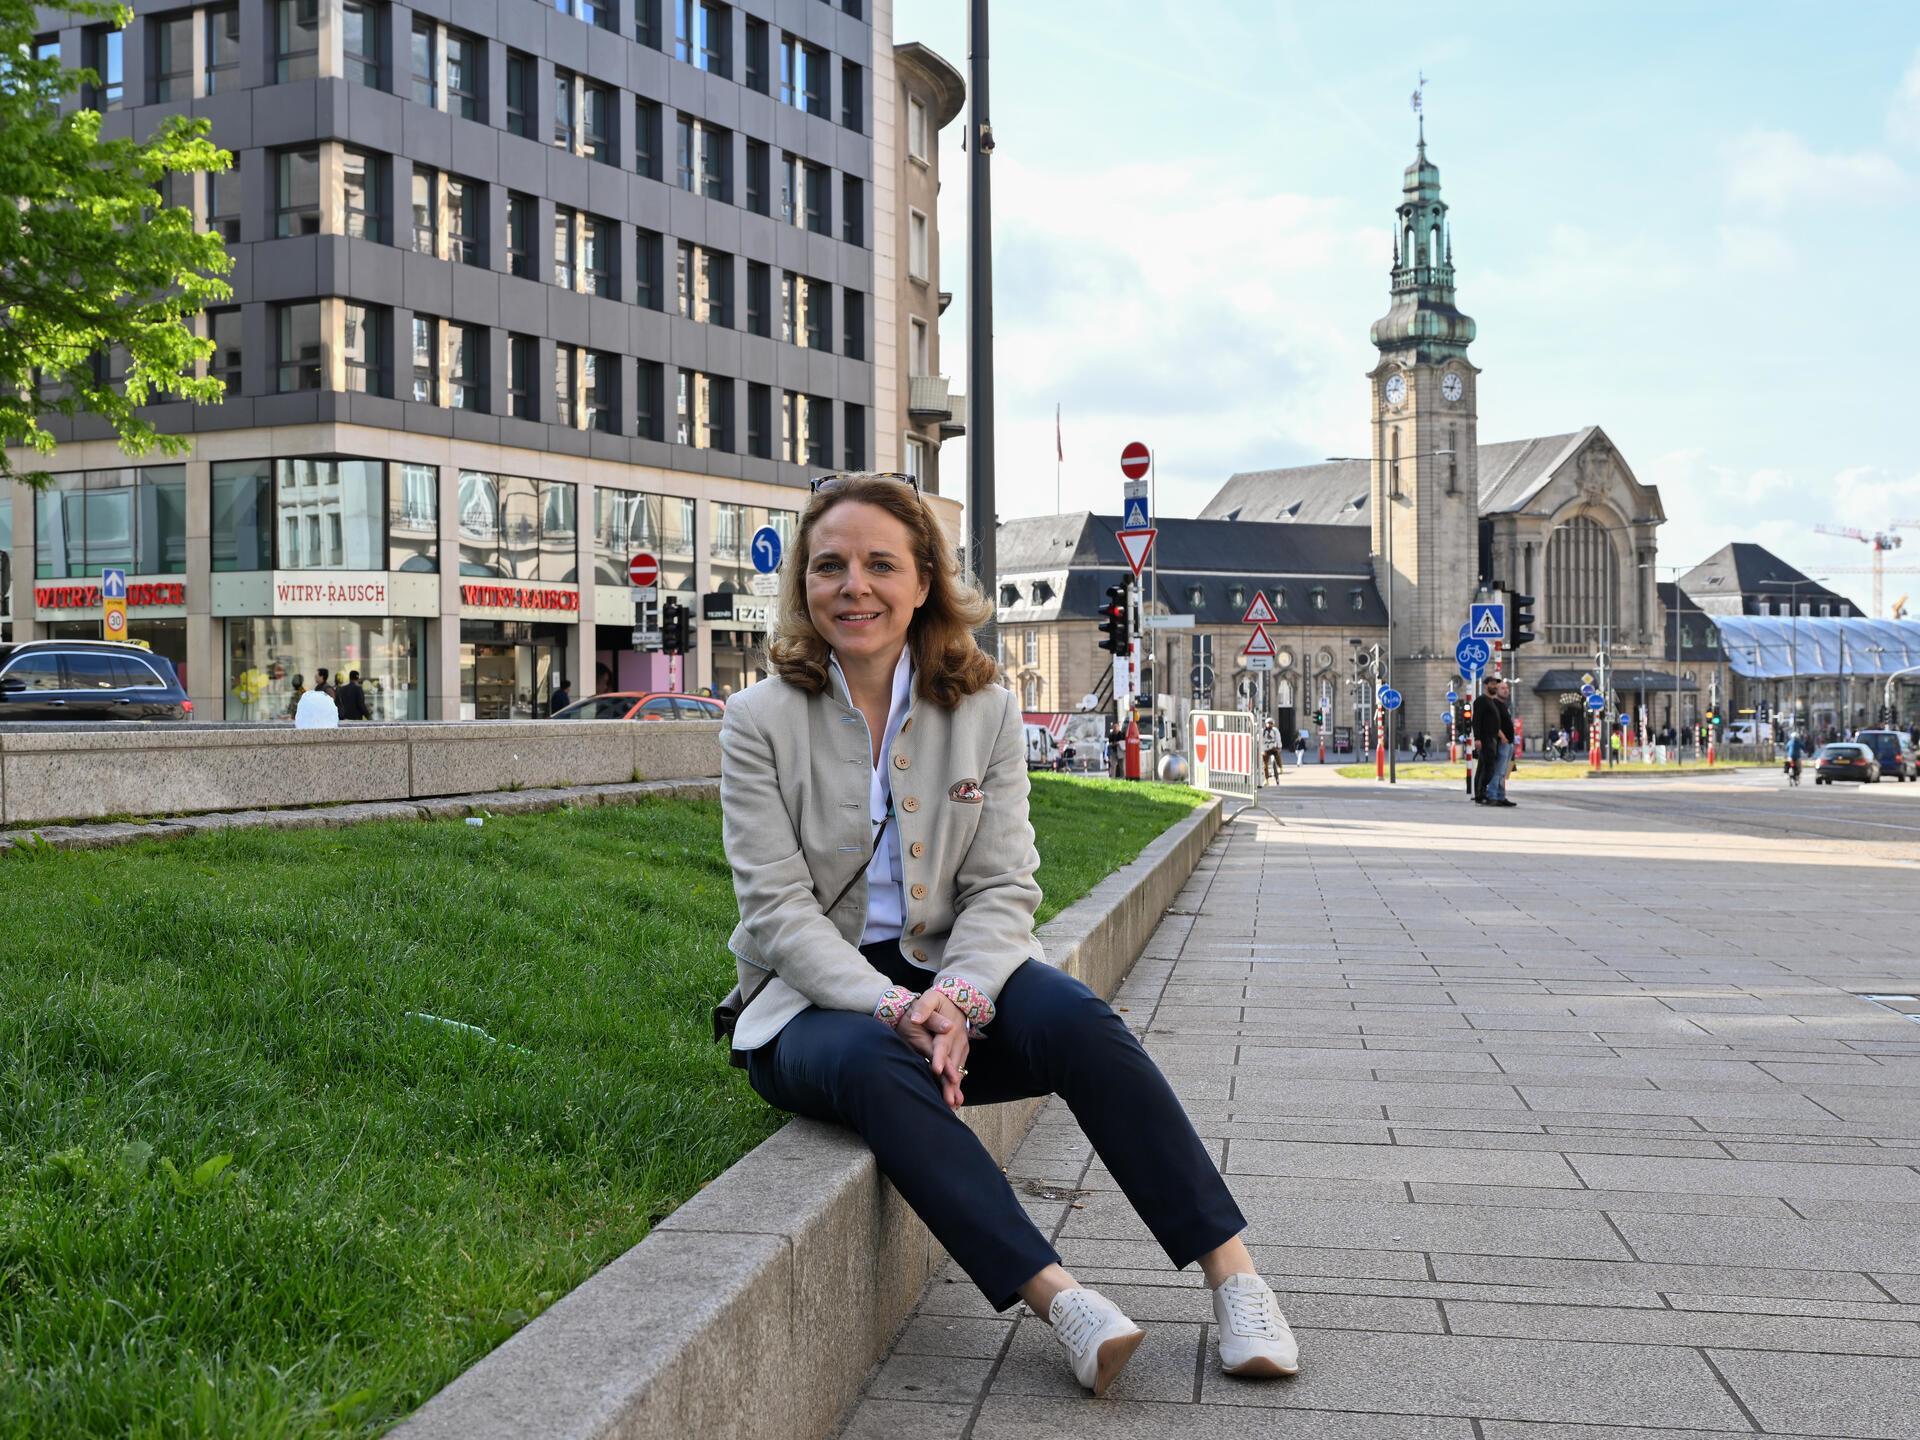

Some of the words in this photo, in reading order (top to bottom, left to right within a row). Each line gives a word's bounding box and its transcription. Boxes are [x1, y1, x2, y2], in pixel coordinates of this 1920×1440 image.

[33, 583, 185, 609] WITRY-USCH
[277, 584, 385, 602] WITRY-RAUSCH
[110, 615, 121, 626] 30
